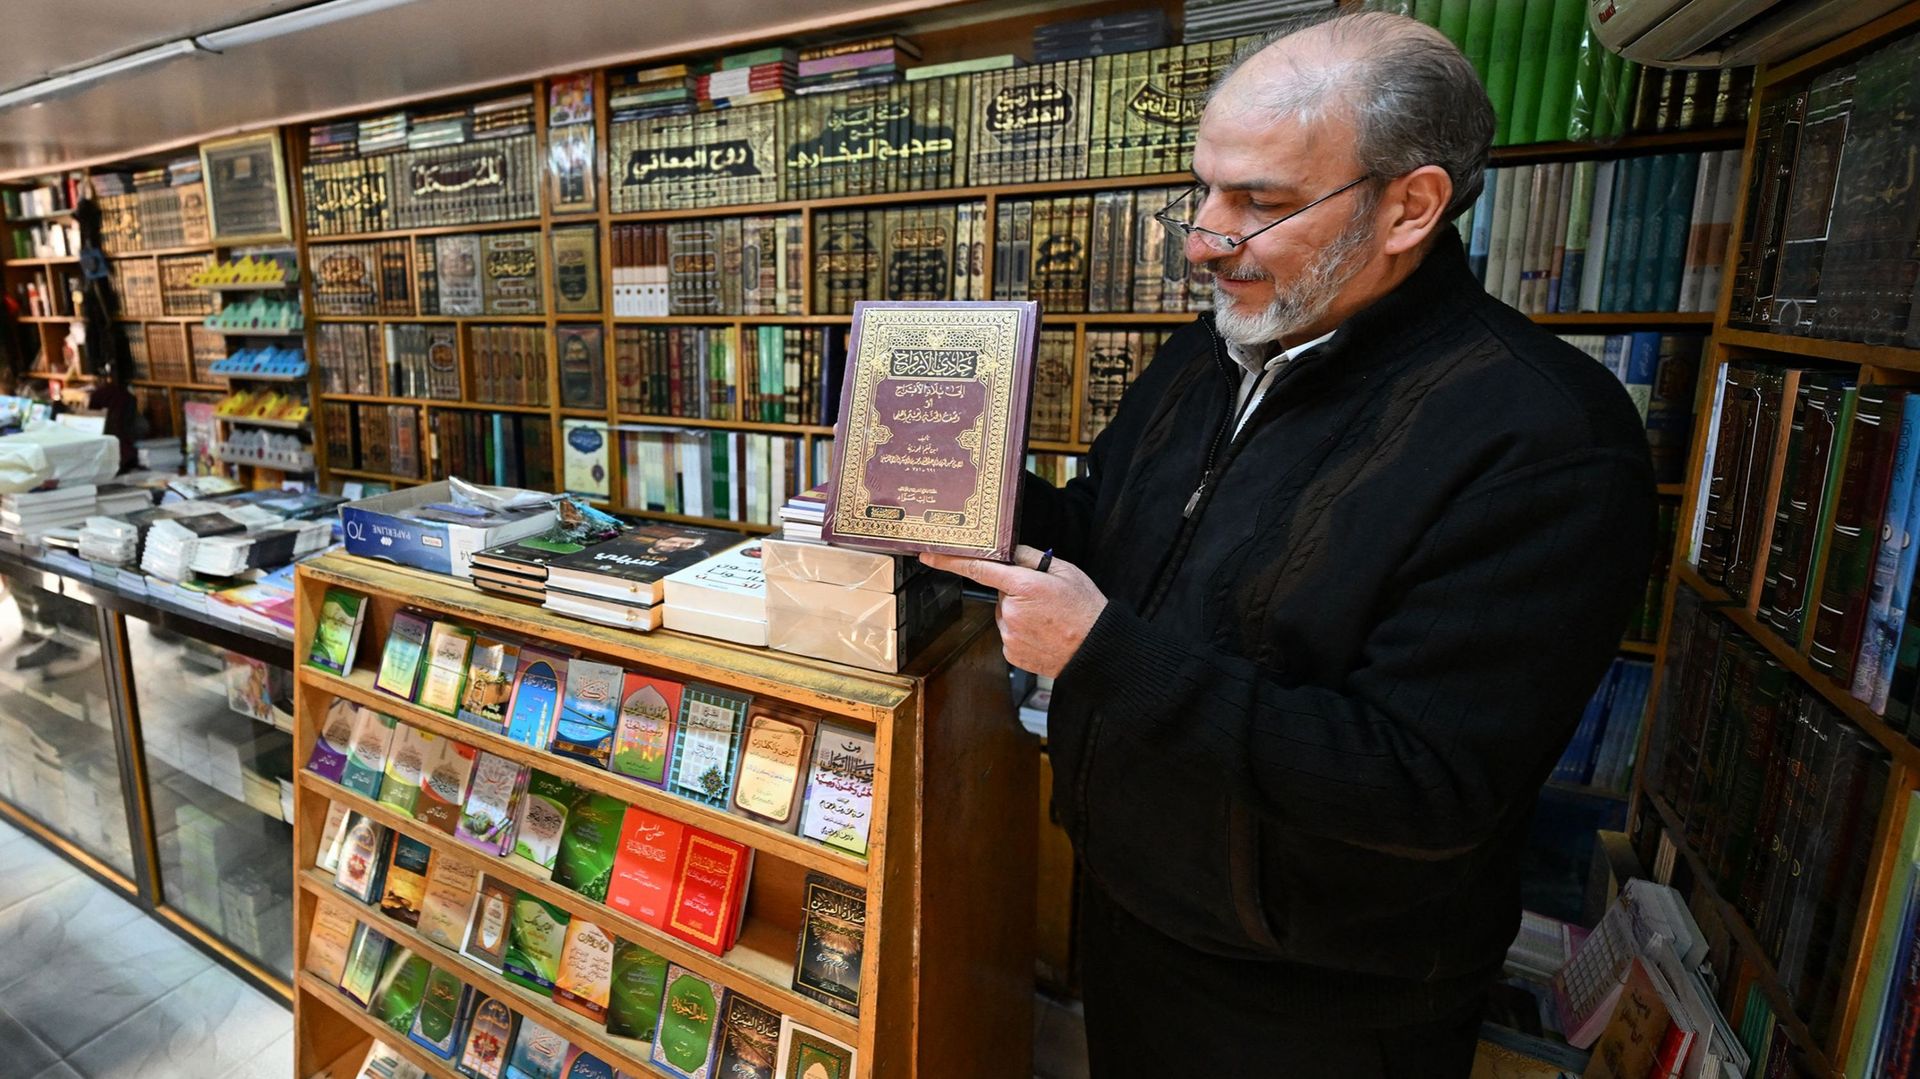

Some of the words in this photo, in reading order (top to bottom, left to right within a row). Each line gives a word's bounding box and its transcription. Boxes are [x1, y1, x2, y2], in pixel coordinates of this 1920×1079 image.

[828, 106, 875, 131] الباري
[876, 104, 910, 126] فتح
[709, 146, 747, 170] روح
[787, 138, 877, 169] البخاري
[877, 137, 953, 161] صحيح
[632, 144, 708, 180] المعاني
[893, 350, 937, 376] الأرواح
[932, 350, 976, 377] حادي
[895, 382, 926, 398] الأفراح
[925, 383, 945, 399] بلاد
[945, 383, 966, 399] إلى
[371, 523, 412, 540] PAPERLINE
[593, 551, 660, 567] سبيلي
[633, 820, 661, 840] المسلم
[645, 831, 665, 841] حصن
[811, 900, 843, 916] العيدين
[841, 903, 866, 923] صلاة
[731, 1011, 757, 1028] العيدين
[756, 1019, 779, 1038] صلاة
